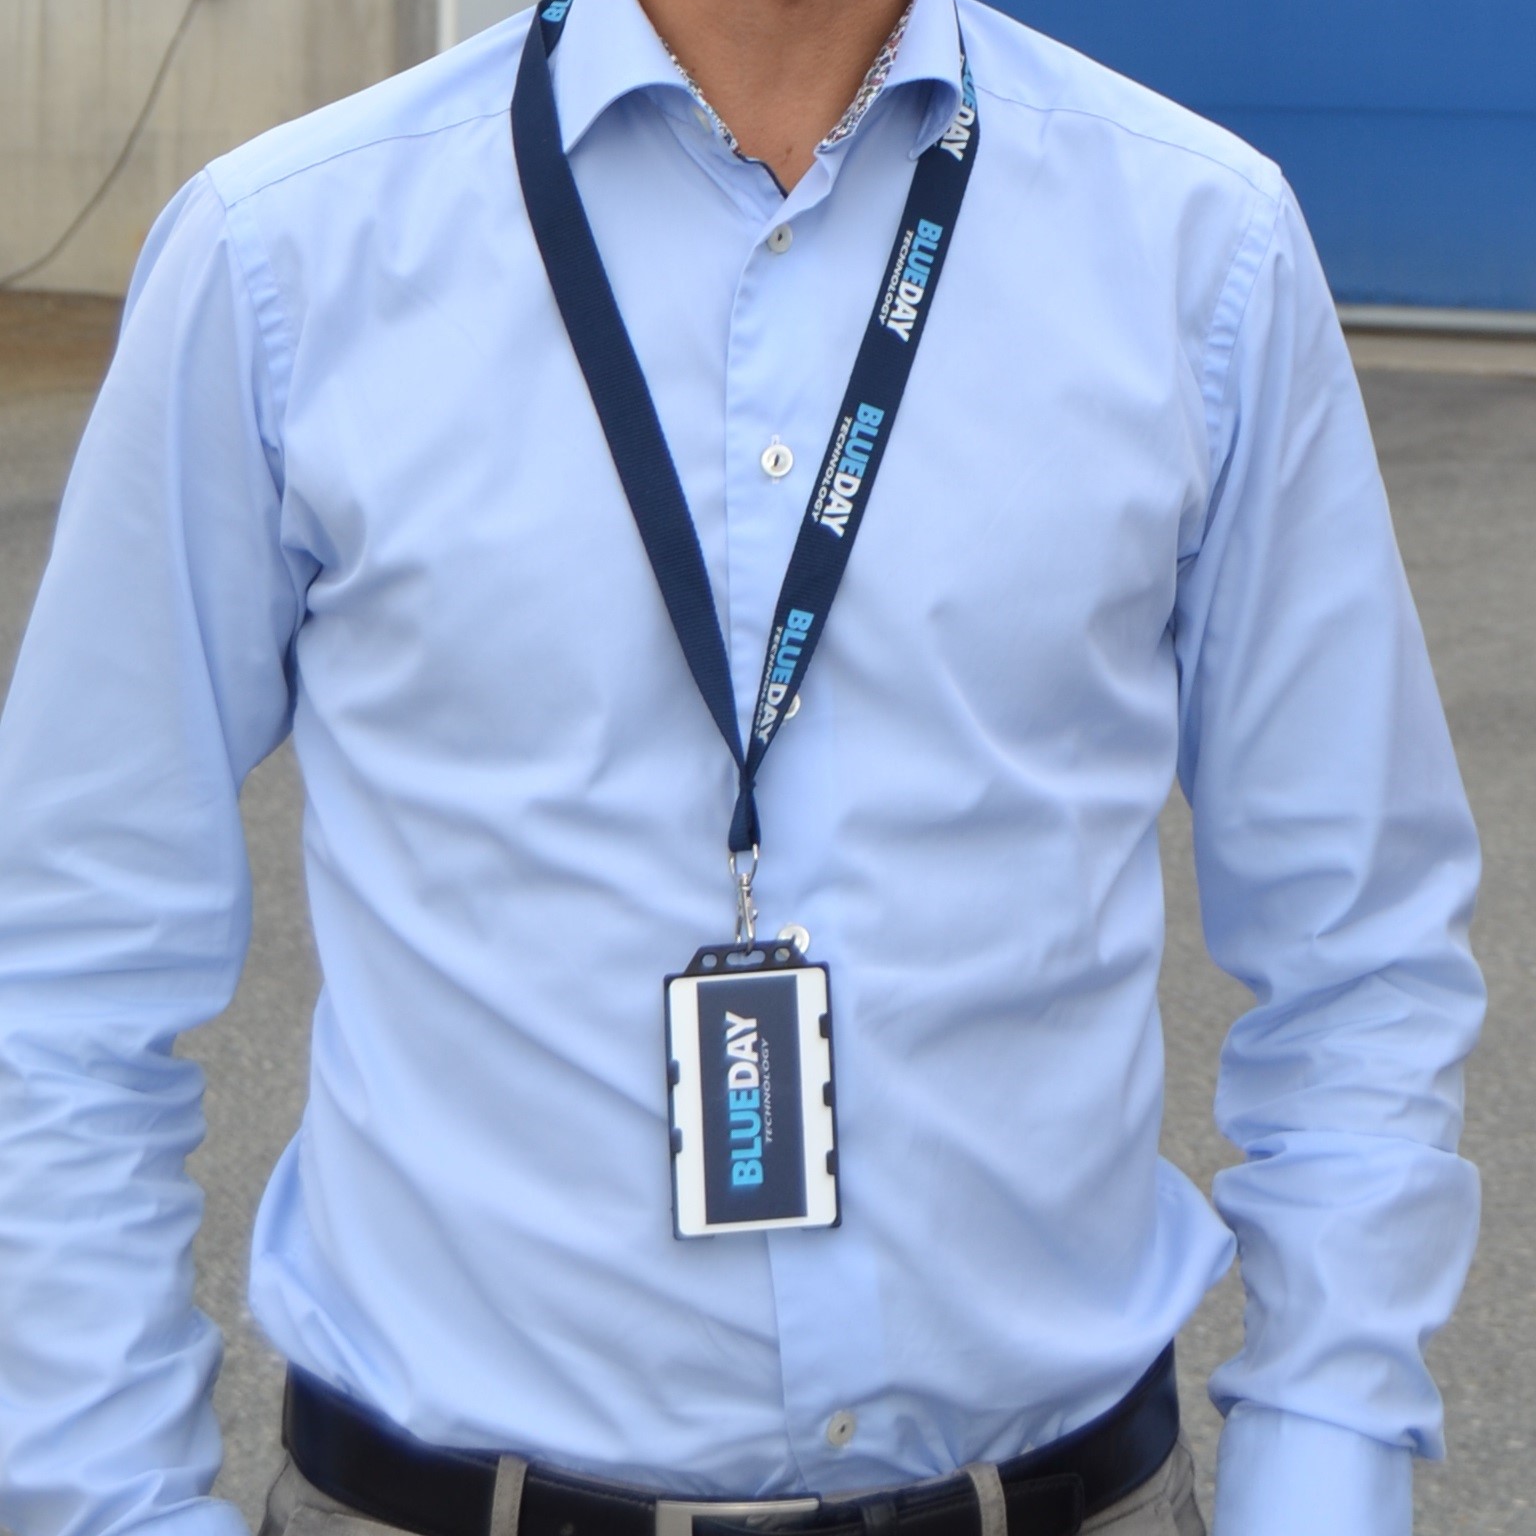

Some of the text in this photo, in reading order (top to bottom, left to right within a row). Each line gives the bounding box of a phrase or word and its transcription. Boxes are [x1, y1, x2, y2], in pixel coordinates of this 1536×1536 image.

[878, 228, 915, 327] TECHNOLOGY
[886, 217, 944, 343] BLUEDAY
[811, 415, 853, 523] TECHNOLOGY
[819, 401, 885, 538] BLUEDAY
[758, 607, 815, 745] BLUEDAY
[724, 1010, 764, 1187] BLUEDAY
[760, 1037, 774, 1144] TECHNOLOGY
